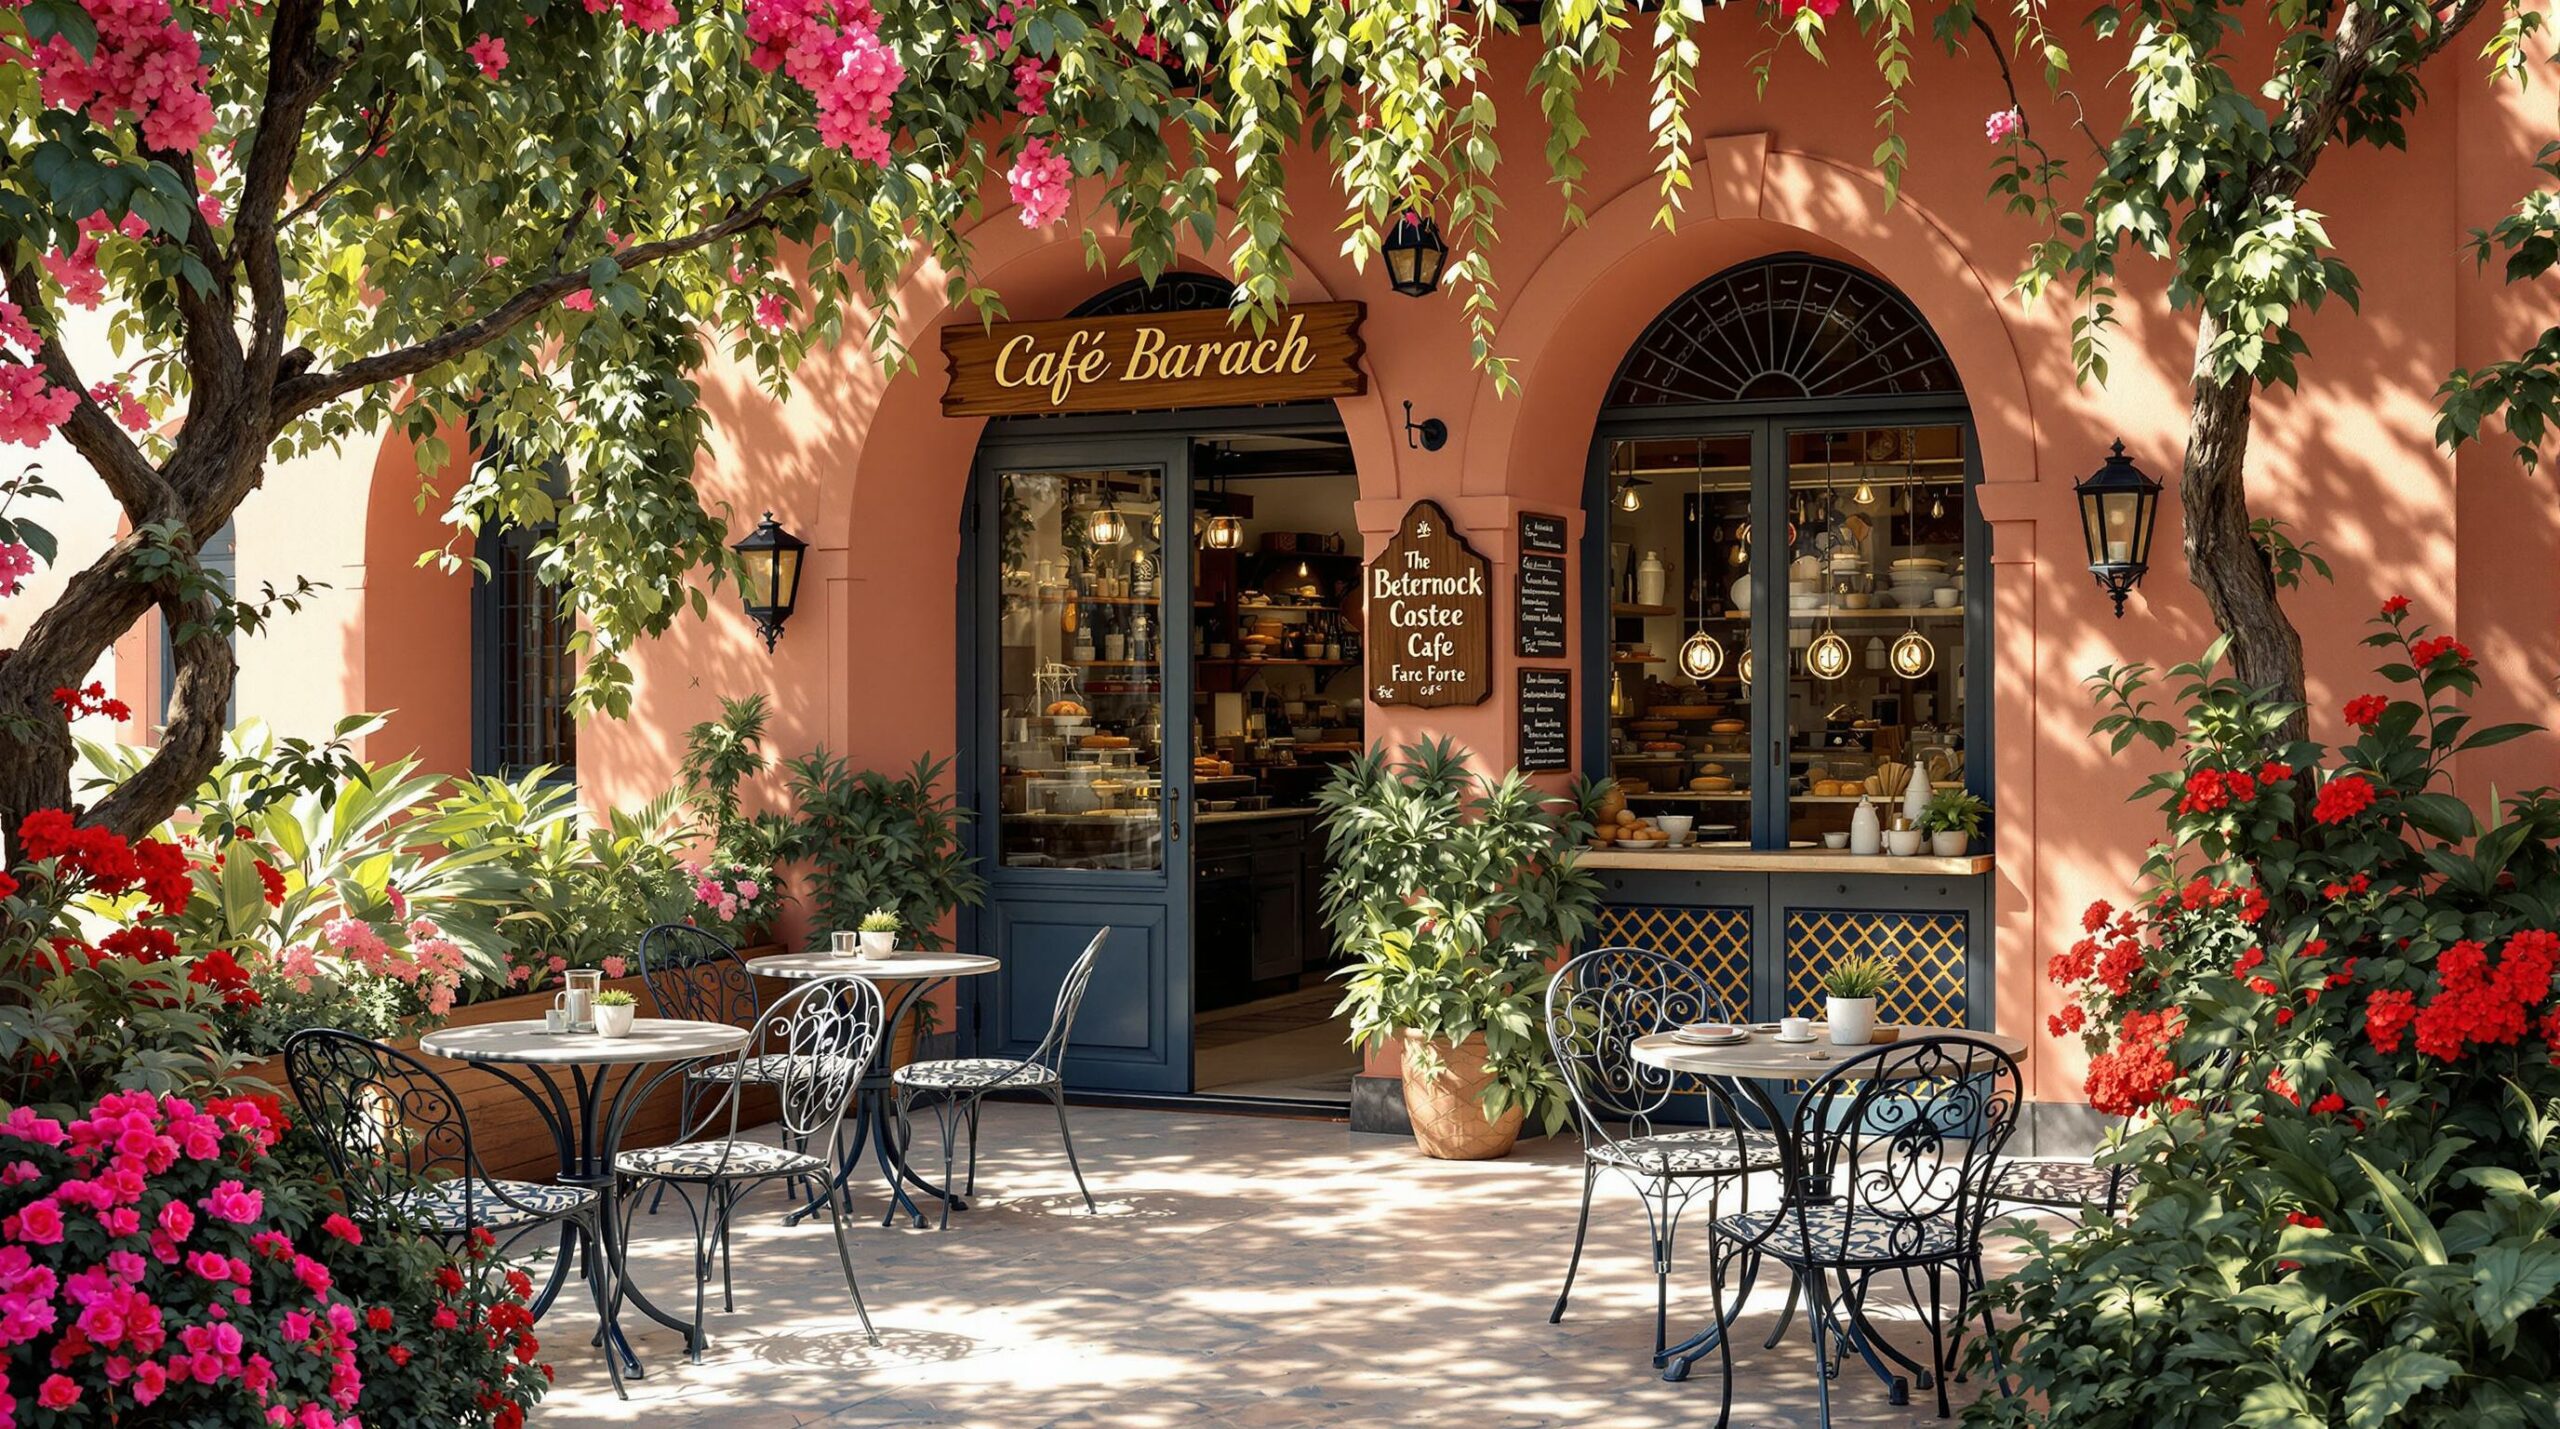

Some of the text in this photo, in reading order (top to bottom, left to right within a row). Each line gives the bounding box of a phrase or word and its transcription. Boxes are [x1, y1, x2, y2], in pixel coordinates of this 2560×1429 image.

[994, 313, 1316, 406] Café Barach
[1404, 550, 1431, 570] The
[1373, 567, 1484, 599] Beternock
[1407, 632, 1455, 662] Cafe
